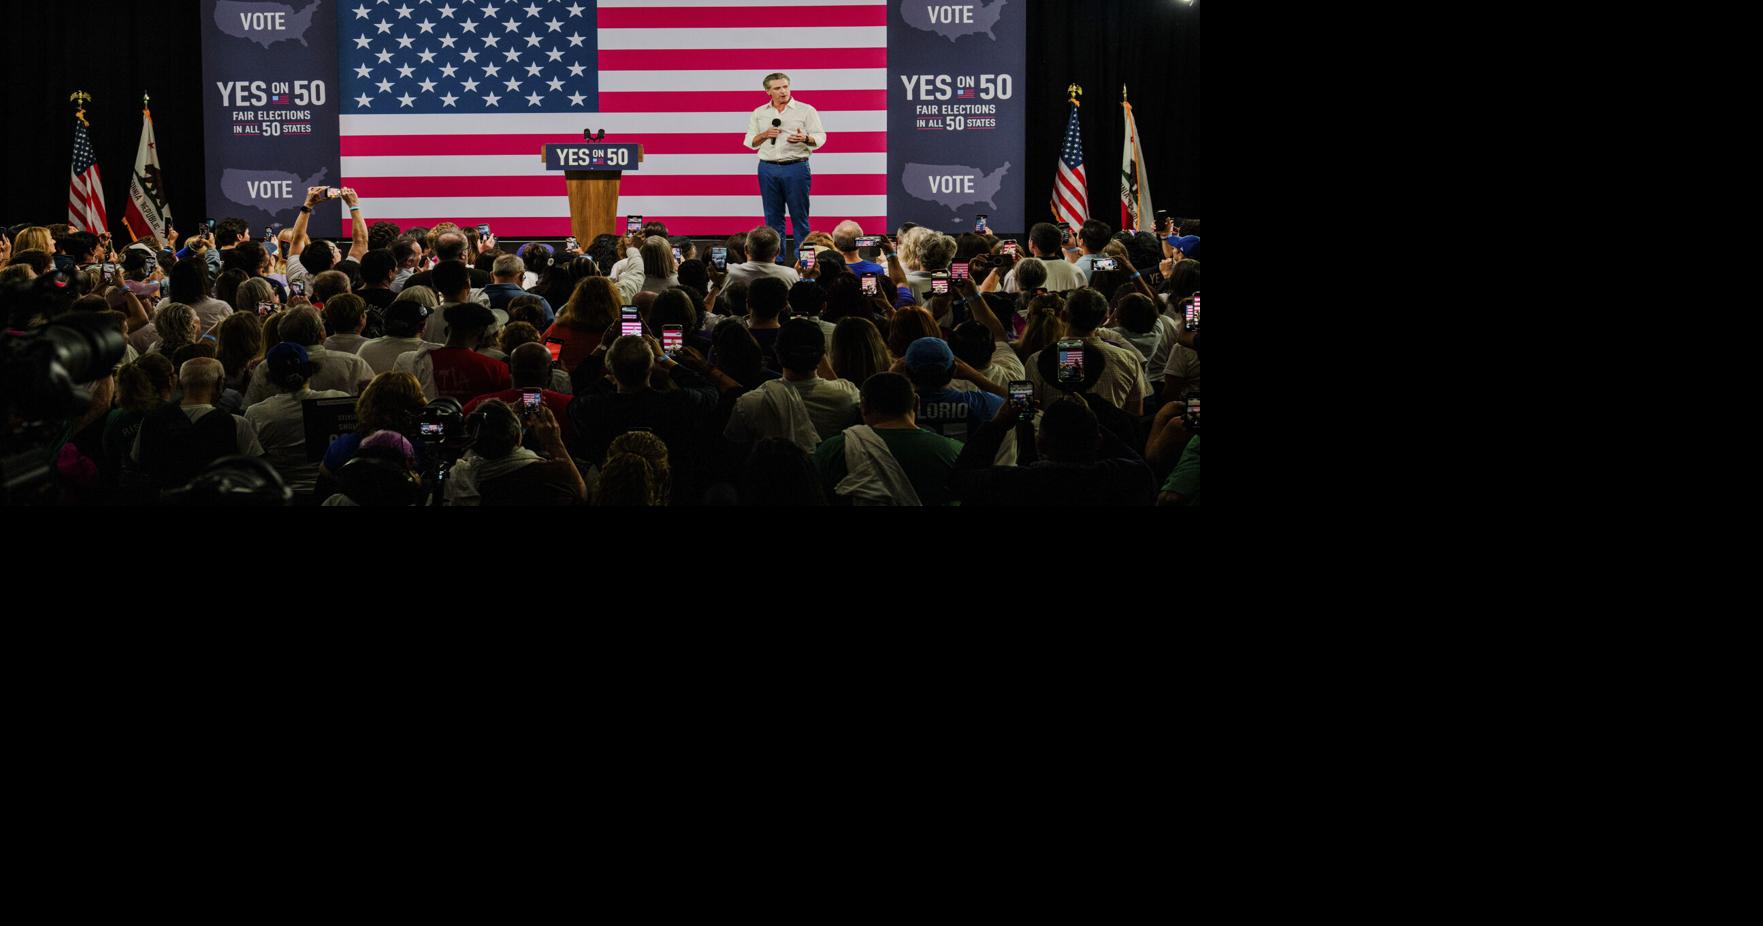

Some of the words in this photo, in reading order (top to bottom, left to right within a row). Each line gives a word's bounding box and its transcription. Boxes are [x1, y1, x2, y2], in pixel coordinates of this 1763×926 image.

[240, 12, 286, 31] VOTE
[927, 5, 974, 24] VOTE
[216, 80, 267, 107] YES
[272, 82, 289, 94] ON
[294, 80, 326, 106] 50
[901, 75, 953, 101] YES
[957, 75, 975, 88] ON
[980, 74, 1013, 100] 50
[232, 111, 255, 121] FAIR
[258, 110, 311, 121] ELECTIONS
[916, 105, 939, 115] FAIR
[942, 104, 996, 115] ELECTIONS
[233, 125, 243, 134] IN
[245, 125, 260, 134] ALL
[262, 122, 281, 137] 50
[283, 125, 312, 133] STATES
[916, 119, 926, 128] IN
[929, 119, 944, 128] ALL
[946, 116, 965, 131] 50
[967, 119, 996, 127] STATES
[556, 148, 590, 166] YES
[593, 149, 605, 158] ON
[608, 148, 629, 166] 50
[247, 181, 293, 199] VOTE
[929, 175, 975, 194] VOTE
